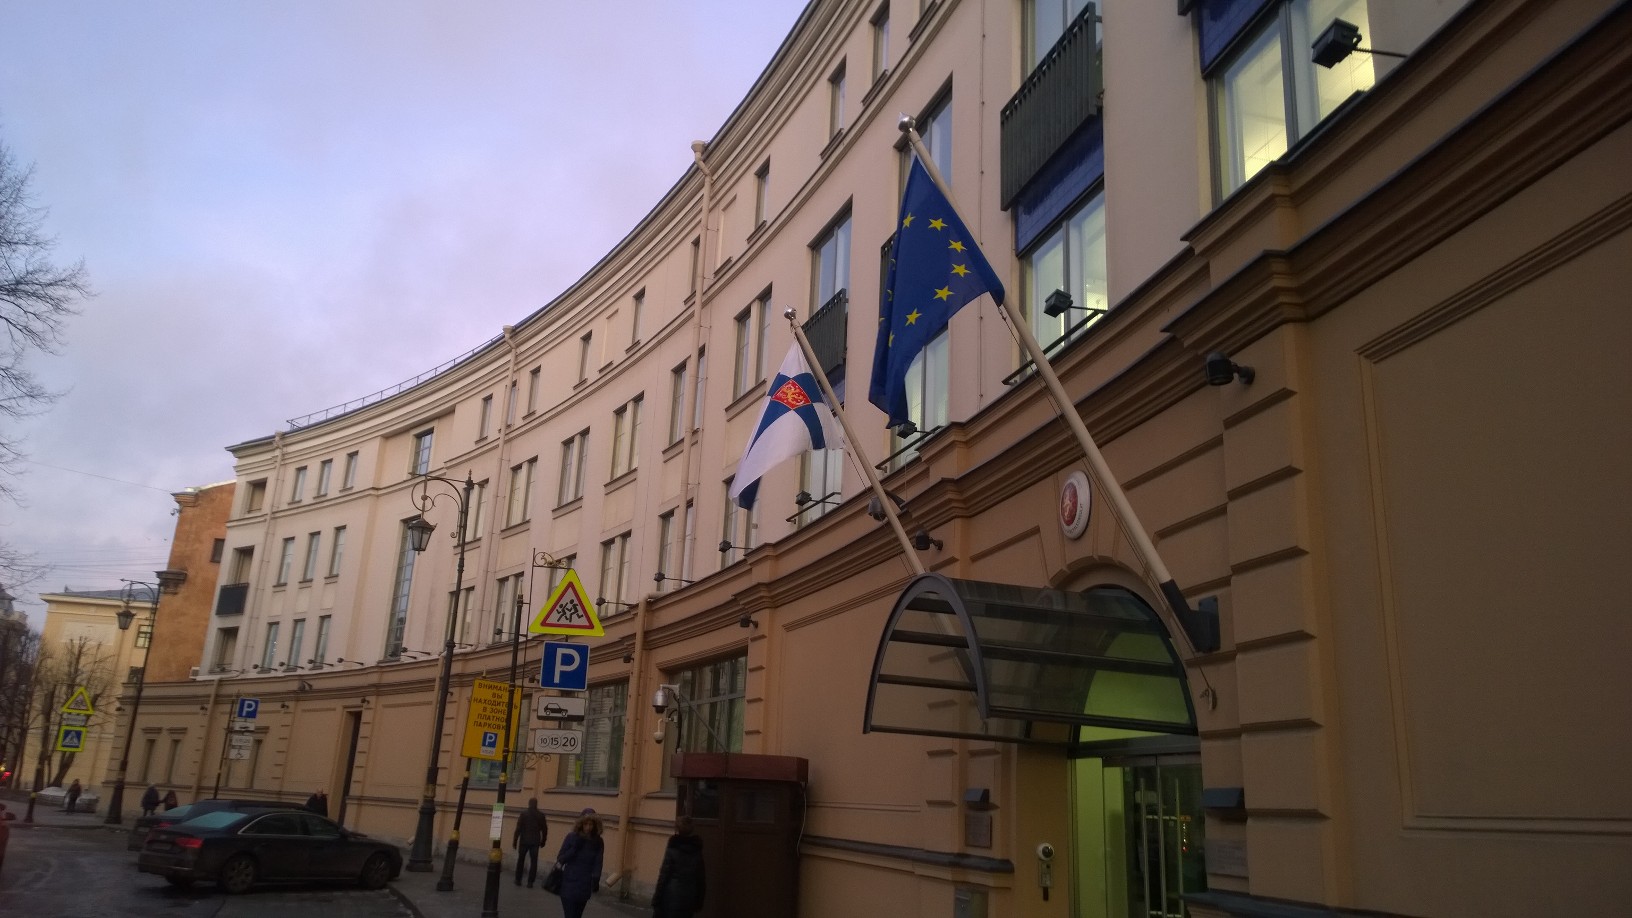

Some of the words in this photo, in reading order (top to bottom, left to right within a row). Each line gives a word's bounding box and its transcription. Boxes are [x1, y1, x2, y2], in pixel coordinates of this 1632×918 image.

[553, 647, 581, 684] P
[477, 682, 519, 693] ВНИМАН!
[242, 700, 256, 717] P
[473, 697, 518, 710] НАХОДИТЬ
[489, 707, 507, 716] ЗОНЕ
[477, 713, 506, 723] ПЛАТНО
[473, 720, 507, 731] ПАРКОВК
[485, 733, 496, 746] P
[540, 737, 548, 745] 10
[550, 736, 559, 746] 15
[562, 736, 576, 747] 20
